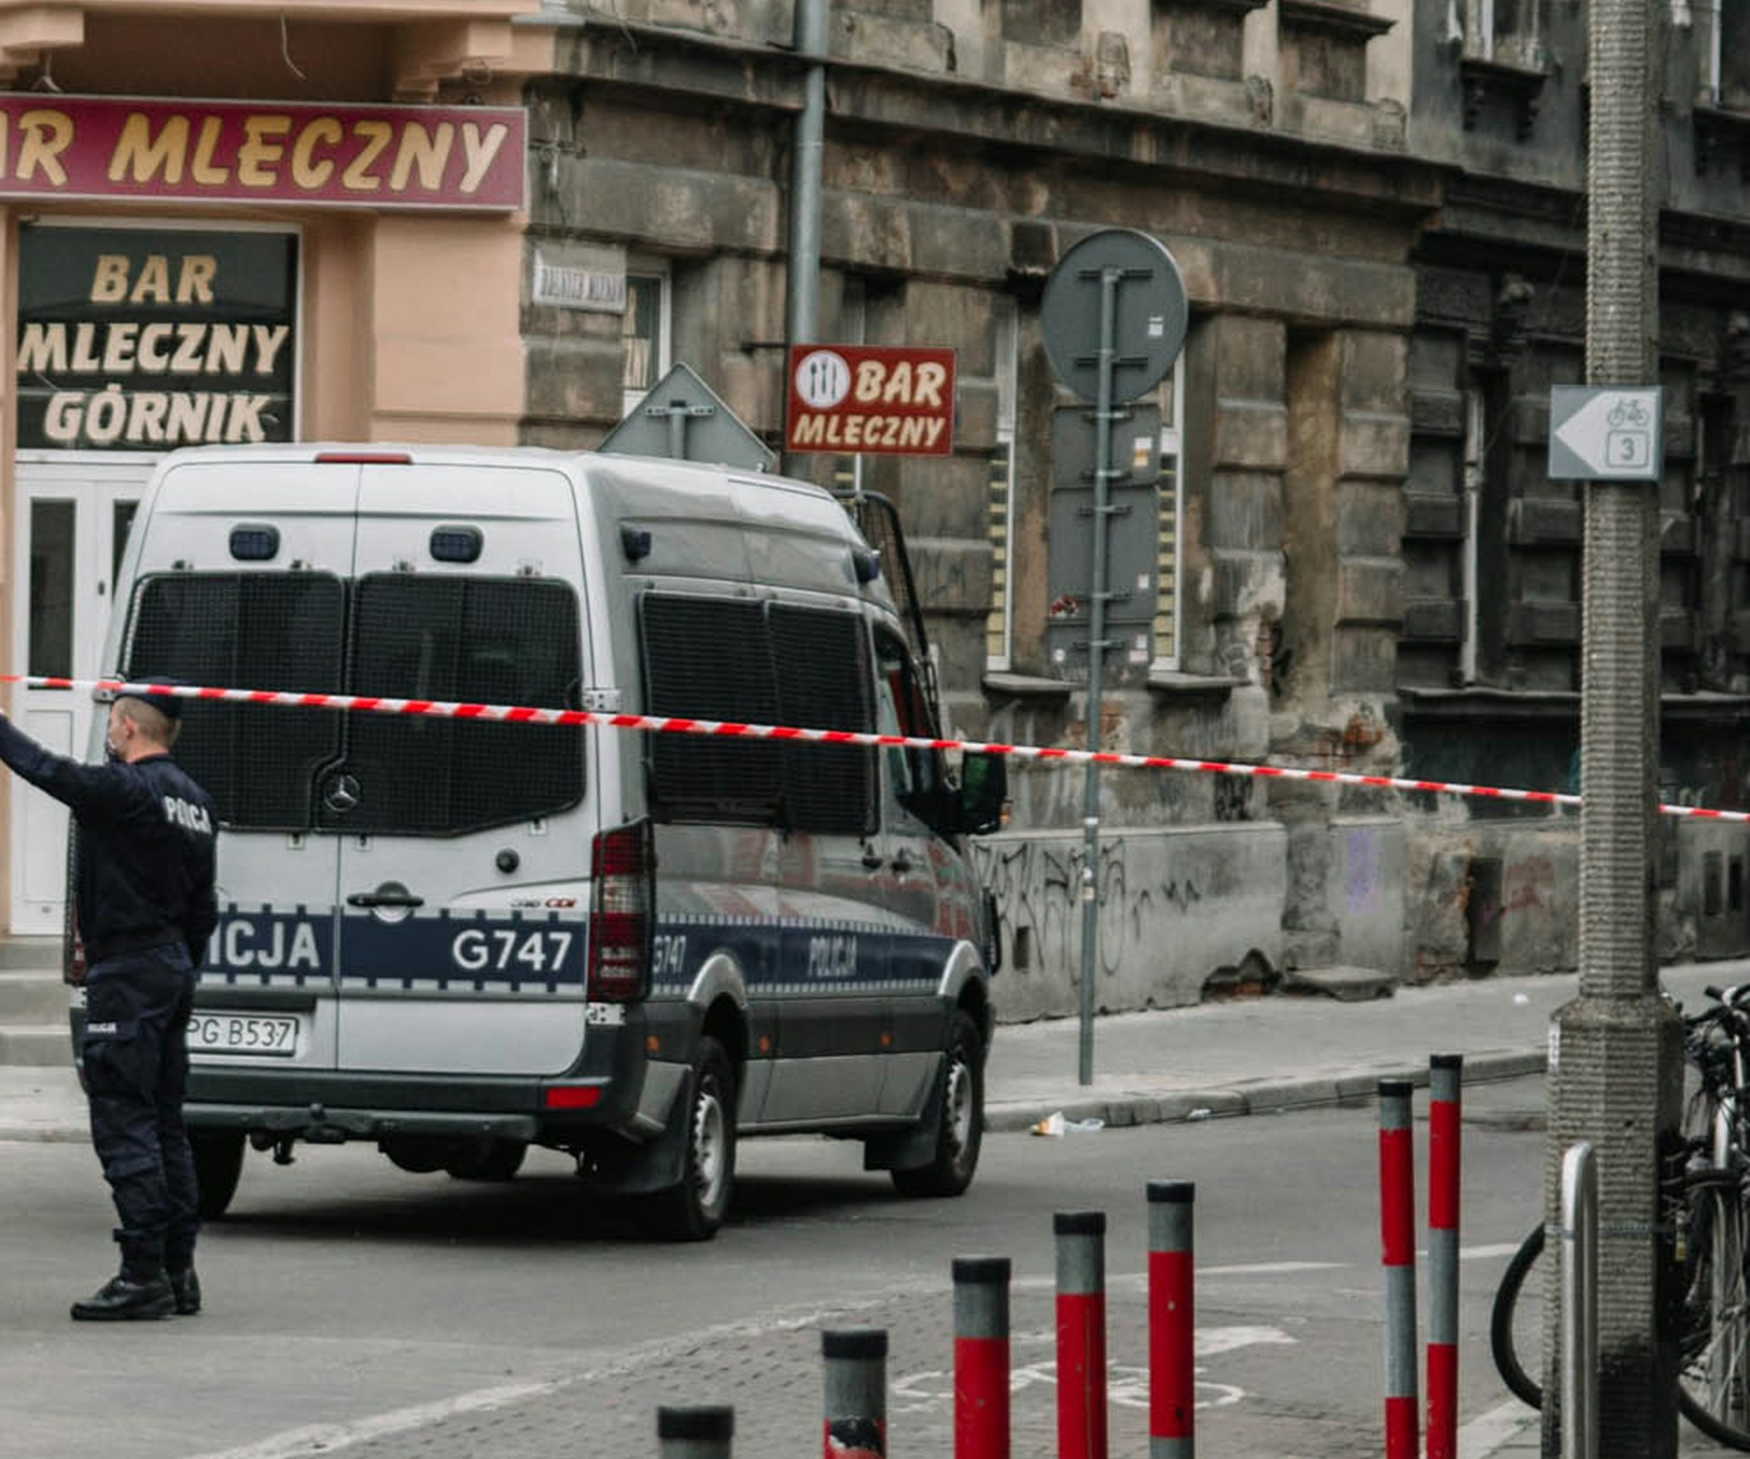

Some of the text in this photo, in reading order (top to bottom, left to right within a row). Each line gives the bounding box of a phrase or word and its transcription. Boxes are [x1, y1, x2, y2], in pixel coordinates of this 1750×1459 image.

[107, 112, 510, 194] MLECZNY
[90, 254, 218, 303] BAR
[16, 322, 290, 374] MLECZNY
[854, 360, 946, 408] BAR
[44, 382, 271, 444] GÓRNIK
[792, 414, 946, 447] MLECZNY
[1621, 437, 1635, 461] 3
[209, 920, 321, 968] ICJA
[453, 929, 573, 972] G747
[228, 1019, 292, 1048] B537
